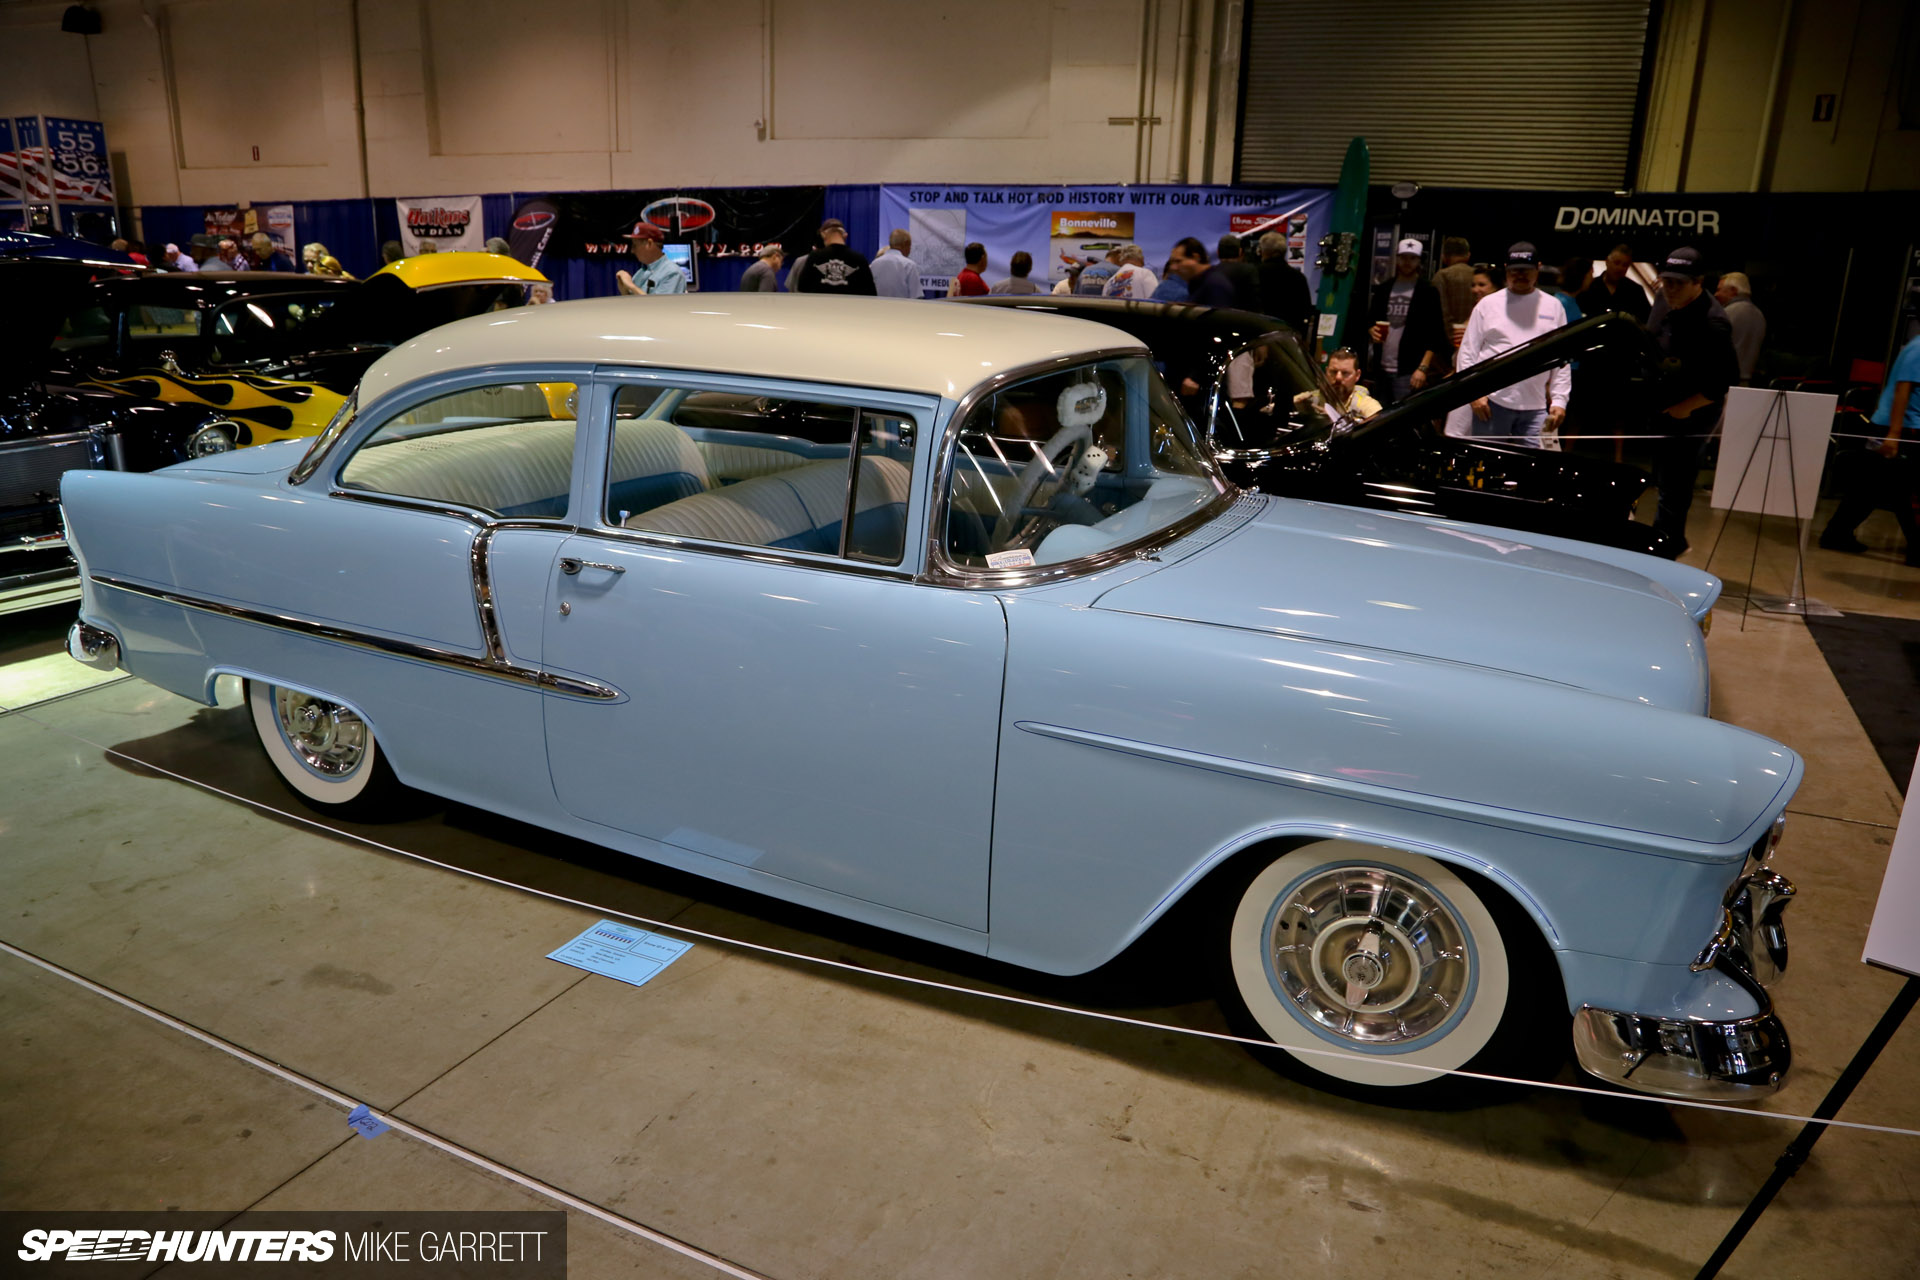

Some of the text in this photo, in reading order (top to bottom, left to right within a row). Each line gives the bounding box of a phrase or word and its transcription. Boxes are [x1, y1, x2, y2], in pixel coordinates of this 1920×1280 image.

[58, 131, 96, 152] 55
[60, 154, 99, 175] 56
[909, 191, 1278, 207] STOP AND TALK HOT ROD HISTORY WITH OUR AUTHORS!
[1059, 217, 1118, 229] Bonneville
[1554, 206, 1720, 235] DOMINATOR
[413, 227, 462, 236] BY DEAN
[931, 278, 950, 287] MEDL
